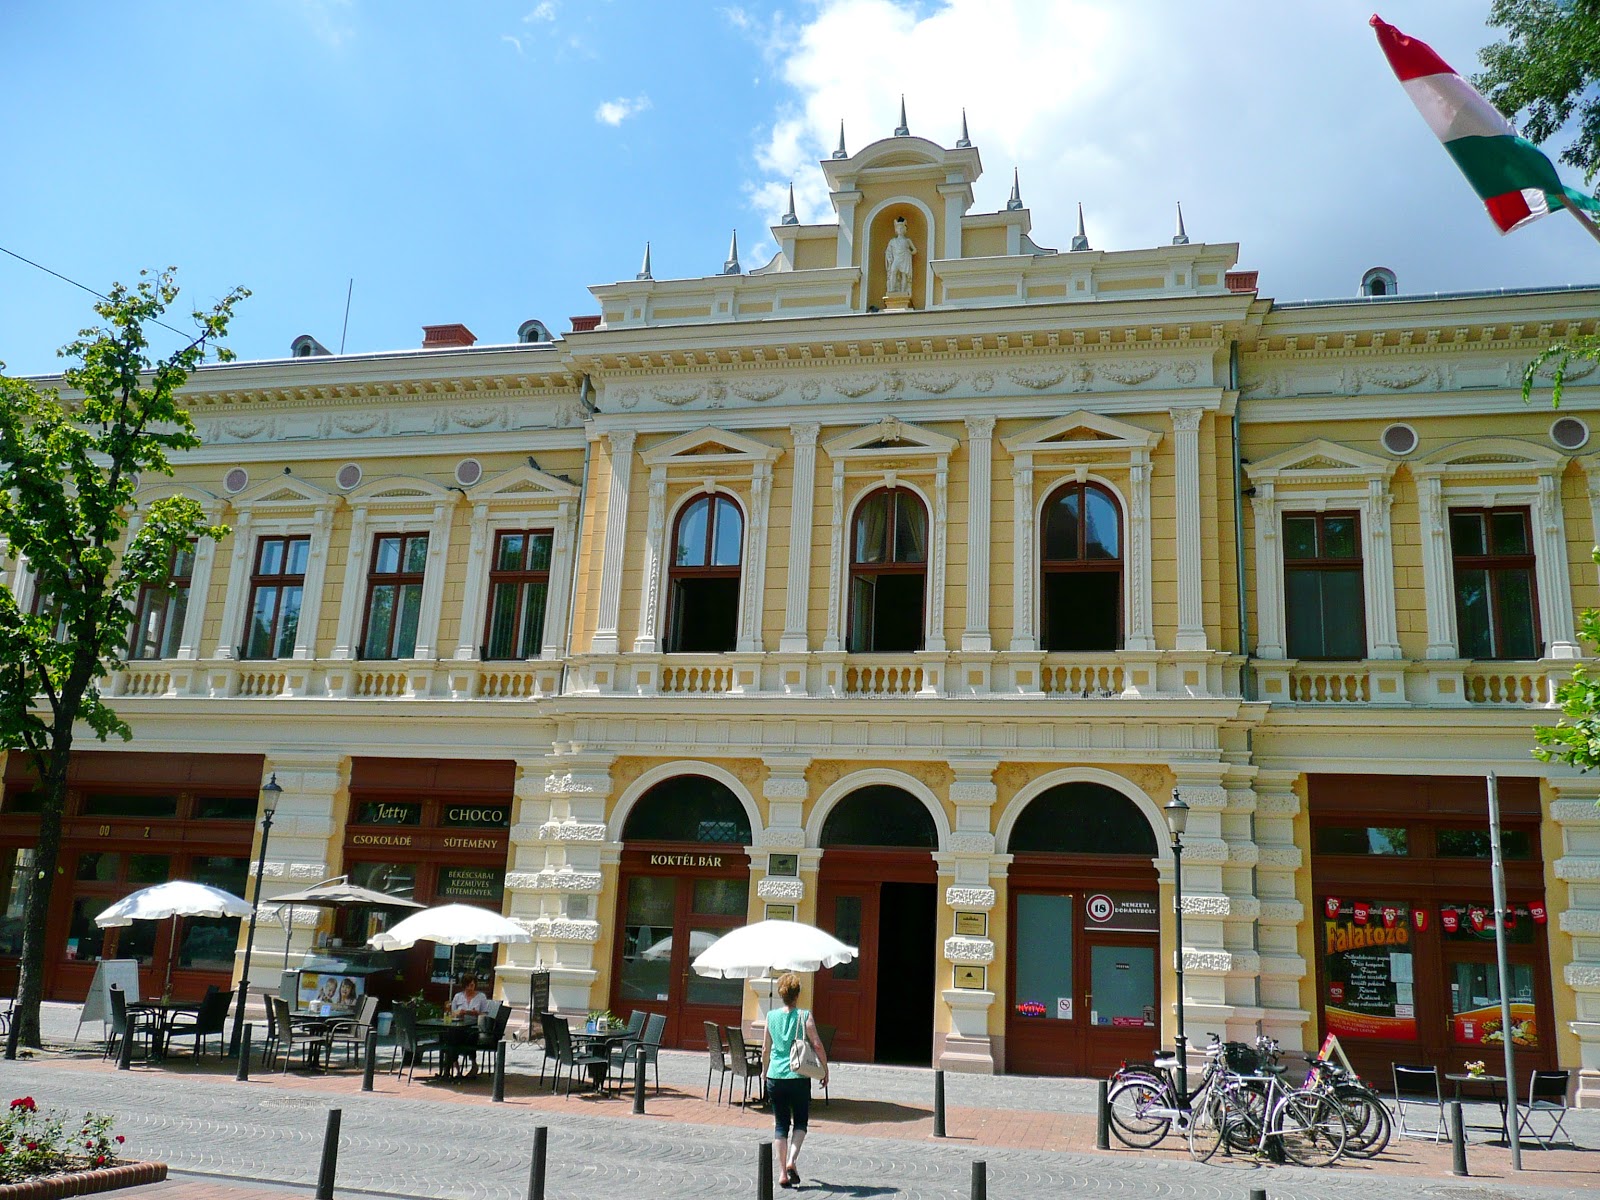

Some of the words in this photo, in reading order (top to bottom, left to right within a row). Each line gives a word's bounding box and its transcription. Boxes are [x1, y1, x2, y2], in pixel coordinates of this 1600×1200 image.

[372, 803, 407, 822] Jetty
[449, 808, 502, 821] CHOCO
[353, 834, 411, 845] CSOKOLÁDÉ
[443, 837, 497, 848] SÜTEMÉNY
[650, 853, 695, 866] KOKTÉL
[698, 854, 721, 867] BÁR
[448, 870, 494, 879] BÉKÉSCSABAI
[446, 887, 492, 896] SÜTEMÉNYEK
[1094, 903, 1106, 912] 18
[1325, 921, 1408, 954] Falatozó
